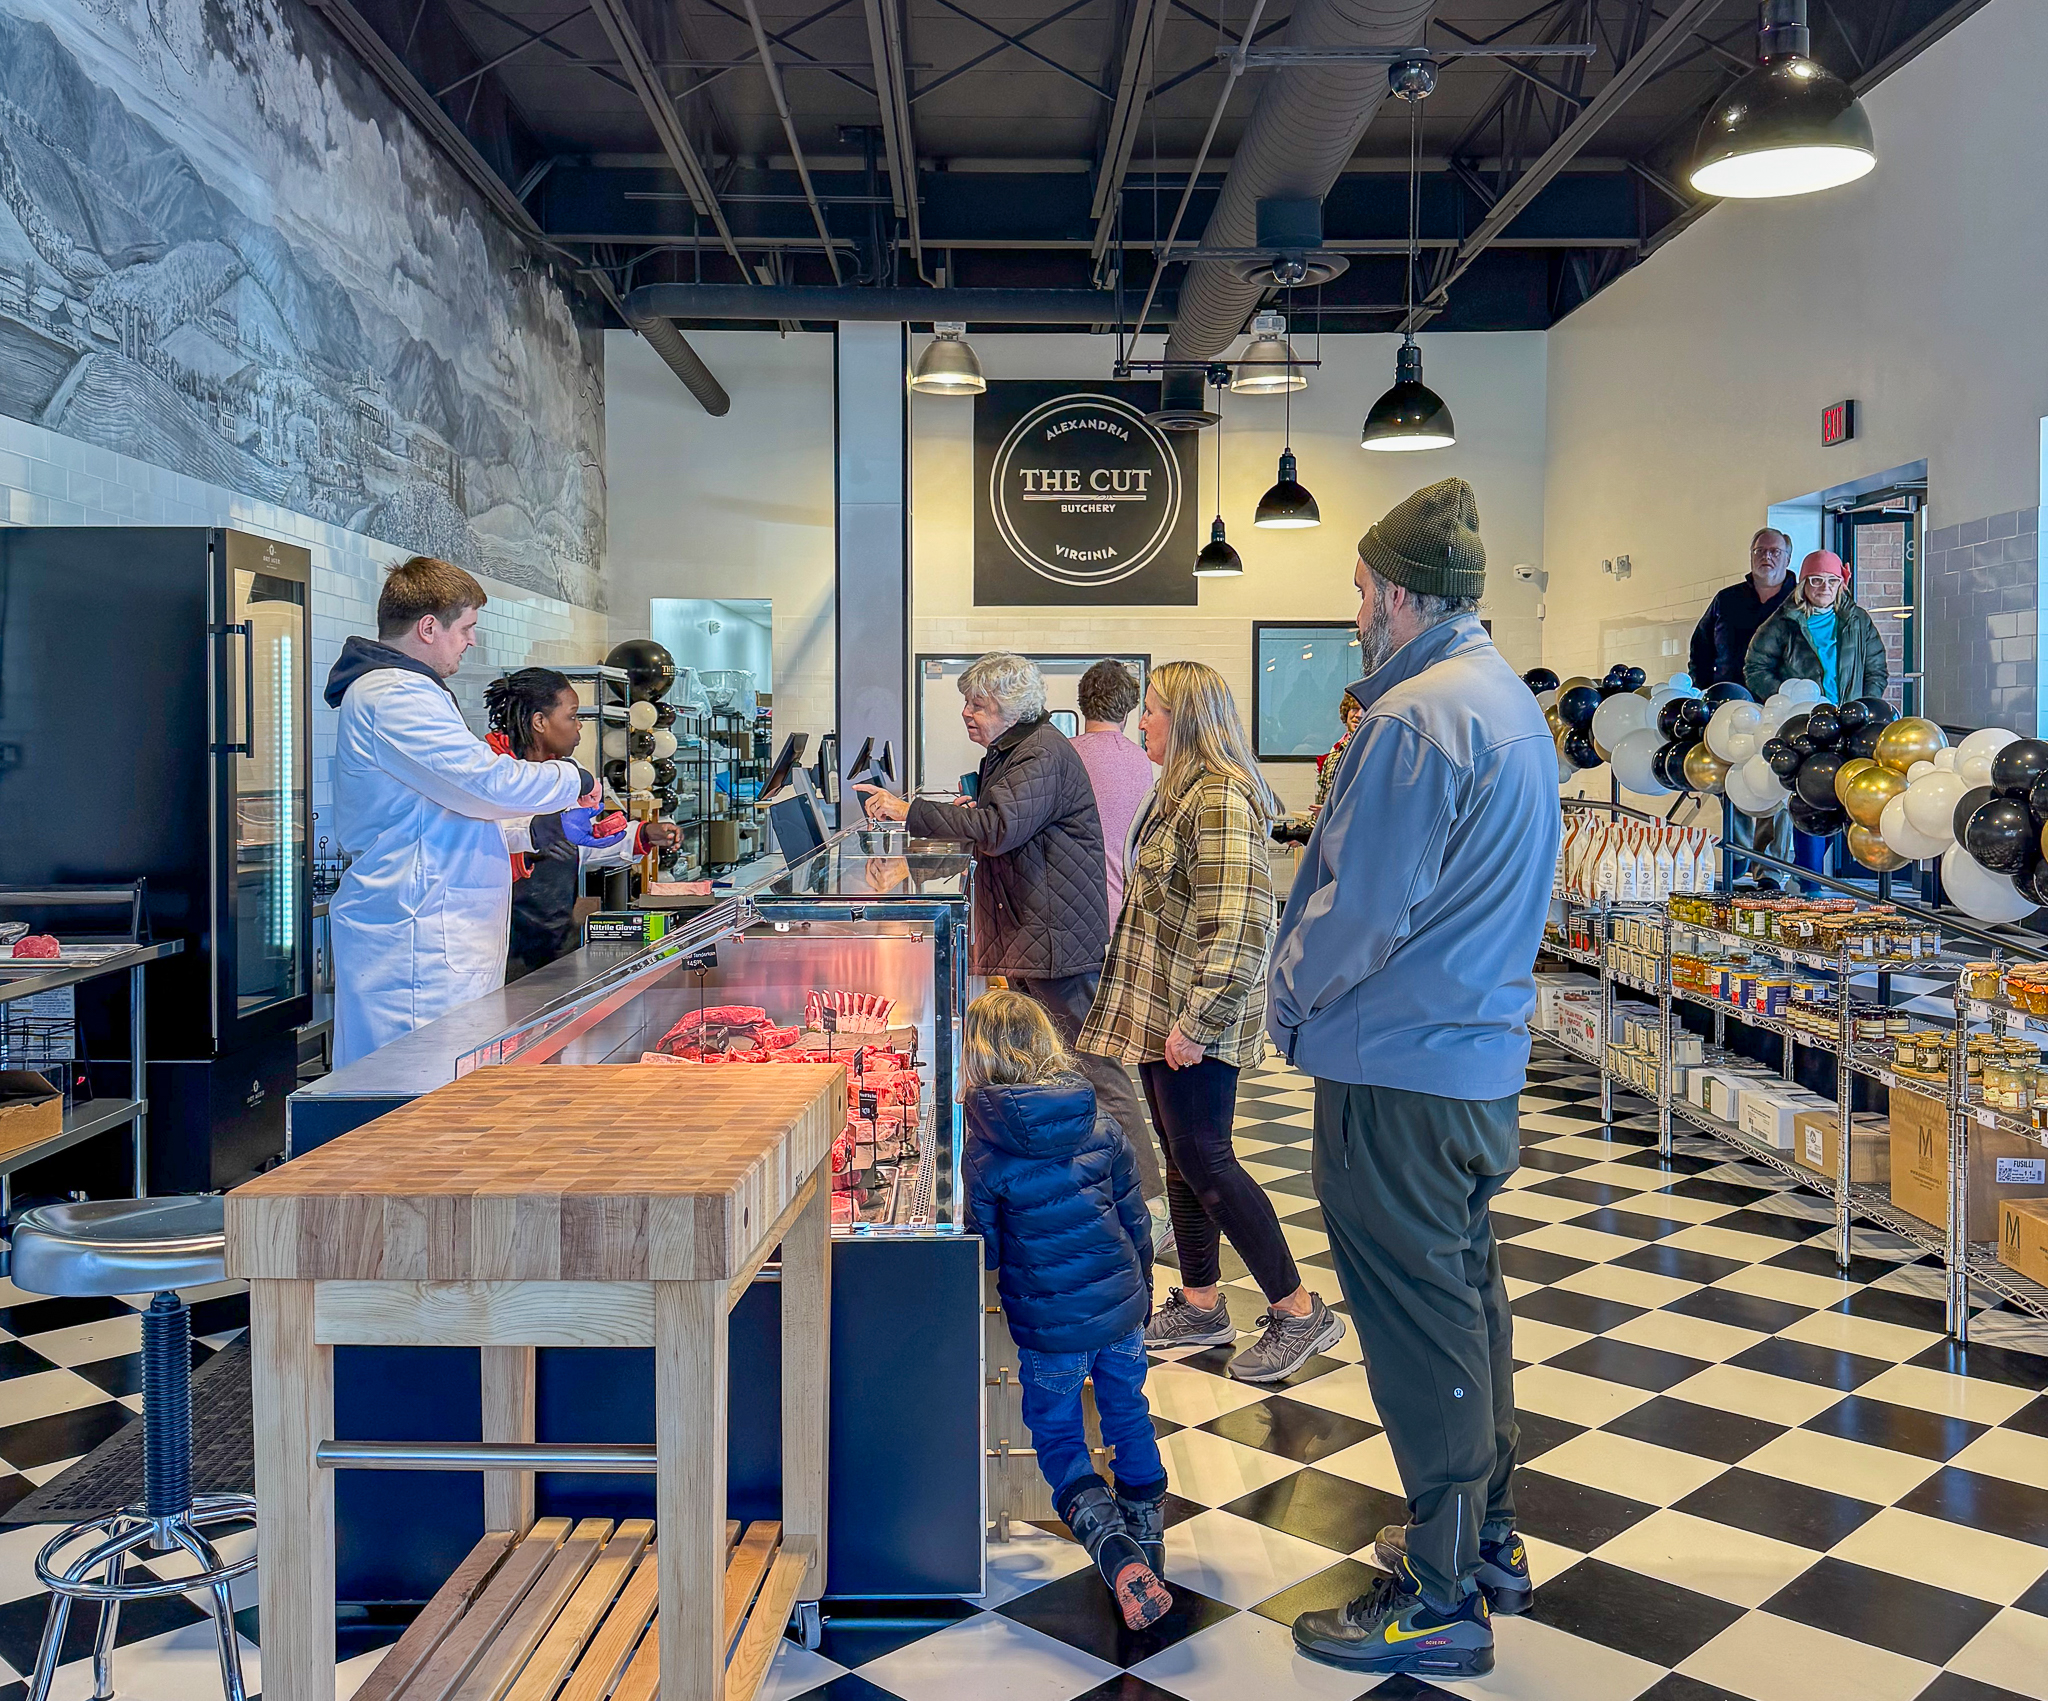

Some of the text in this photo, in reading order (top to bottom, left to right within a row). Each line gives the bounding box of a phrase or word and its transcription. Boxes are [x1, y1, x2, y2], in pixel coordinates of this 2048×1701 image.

[1046, 418, 1129, 442] ALEXANDRIA
[1824, 406, 1844, 442] EXIT
[1019, 468, 1152, 492] THE CUT
[1061, 503, 1116, 513] BUTCHERY
[1055, 544, 1118, 561] VIRGINIA
[1919, 1126, 1933, 1159] M
[2013, 1160, 2034, 1168] FUSILLI
[2005, 1210, 2020, 1249] M
